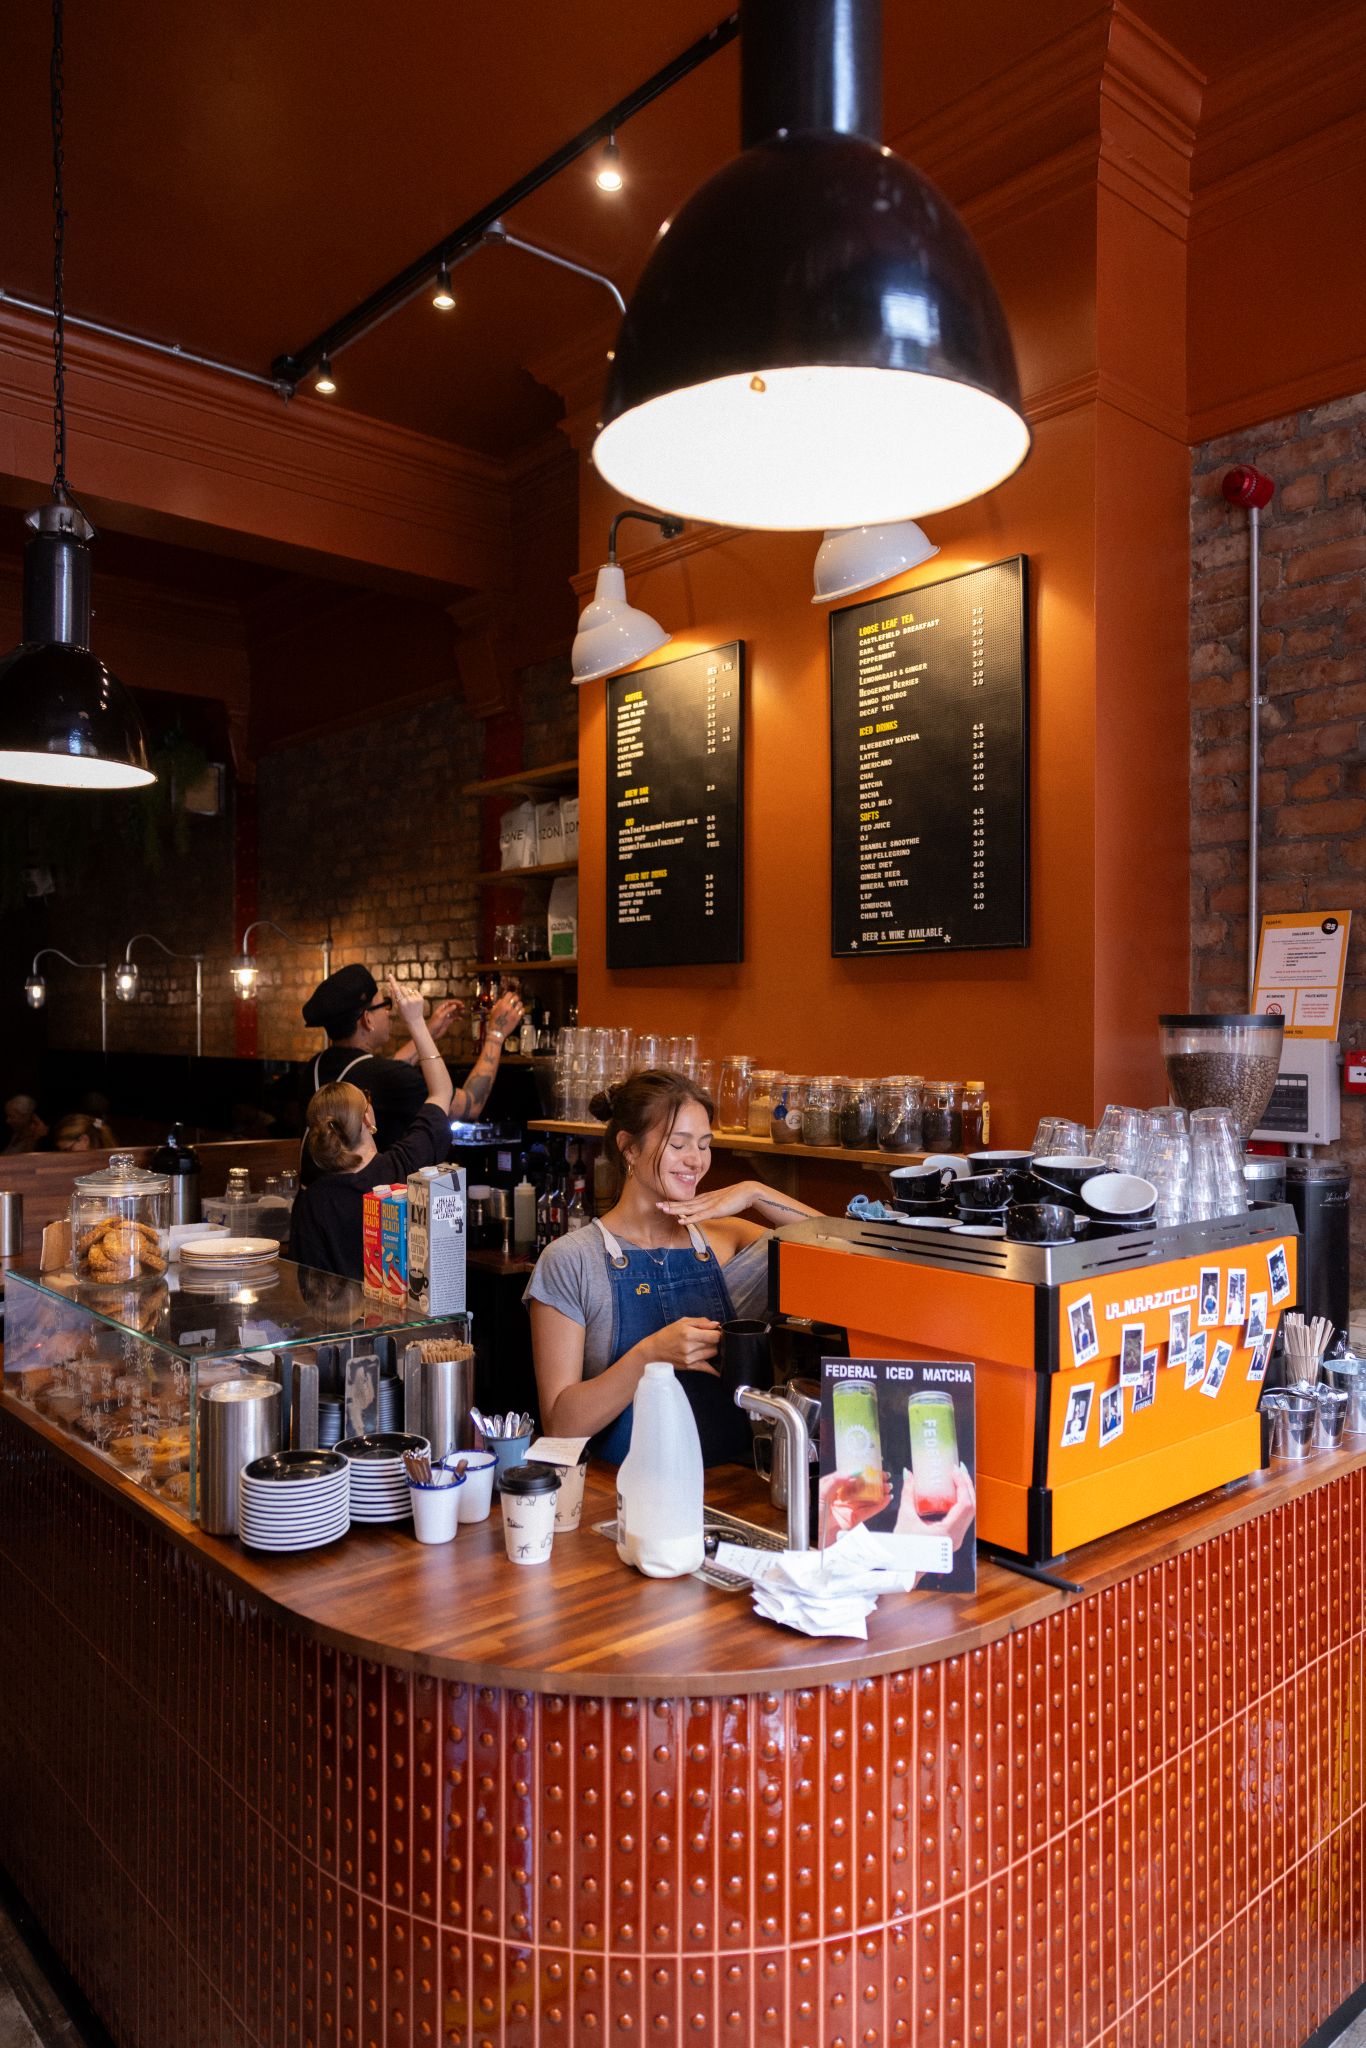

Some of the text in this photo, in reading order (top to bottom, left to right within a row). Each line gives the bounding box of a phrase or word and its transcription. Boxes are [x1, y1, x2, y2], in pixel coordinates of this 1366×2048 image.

[859, 614, 914, 636] LOOSE LEAF TEA
[859, 619, 940, 646] CASTLEFIELD BREAKFAST
[859, 641, 895, 656] EARL GREY
[859, 651, 896, 666] PEPPERMINT
[905, 663, 928, 674] GINGER
[893, 677, 919, 689] BERRIES
[859, 691, 907, 707] MANGO ROOIBOS
[859, 704, 894, 717] DECAF TEA
[859, 720, 898, 737] ICED DRINKS
[860, 733, 920, 751] BLUEBERRY MATCHA
[860, 752, 879, 760] LATTE
[860, 759, 892, 770] AMERICANO
[860, 772, 873, 780] CHAI
[860, 781, 883, 790] MATCHA
[860, 791, 879, 800] MOCHA
[860, 811, 879, 821] SOFTS
[539, 825, 563, 839] ZON
[860, 821, 890, 832] FED JUICE
[973, 829, 984, 837] 4.5
[860, 837, 920, 851] BRAMBLE SMOOTHIE
[873, 849, 910, 859] PELLEGRINO
[973, 850, 984, 858] 3.0
[879, 861, 893, 869] DIET
[861, 870, 901, 880] GINGER BEER
[861, 879, 908, 890] MINERAL WATER
[861, 901, 891, 910] KOMBUCHA
[973, 903, 984, 911] 4.0
[862, 927, 943, 941] BEER & WINE AVAILABLE
[364, 1198, 379, 1216] RUDE
[382, 1202, 399, 1221] RUDE
[411, 1204, 427, 1226] LY!
[825, 1364, 972, 1382] FEDERAL ICED MATCHA
